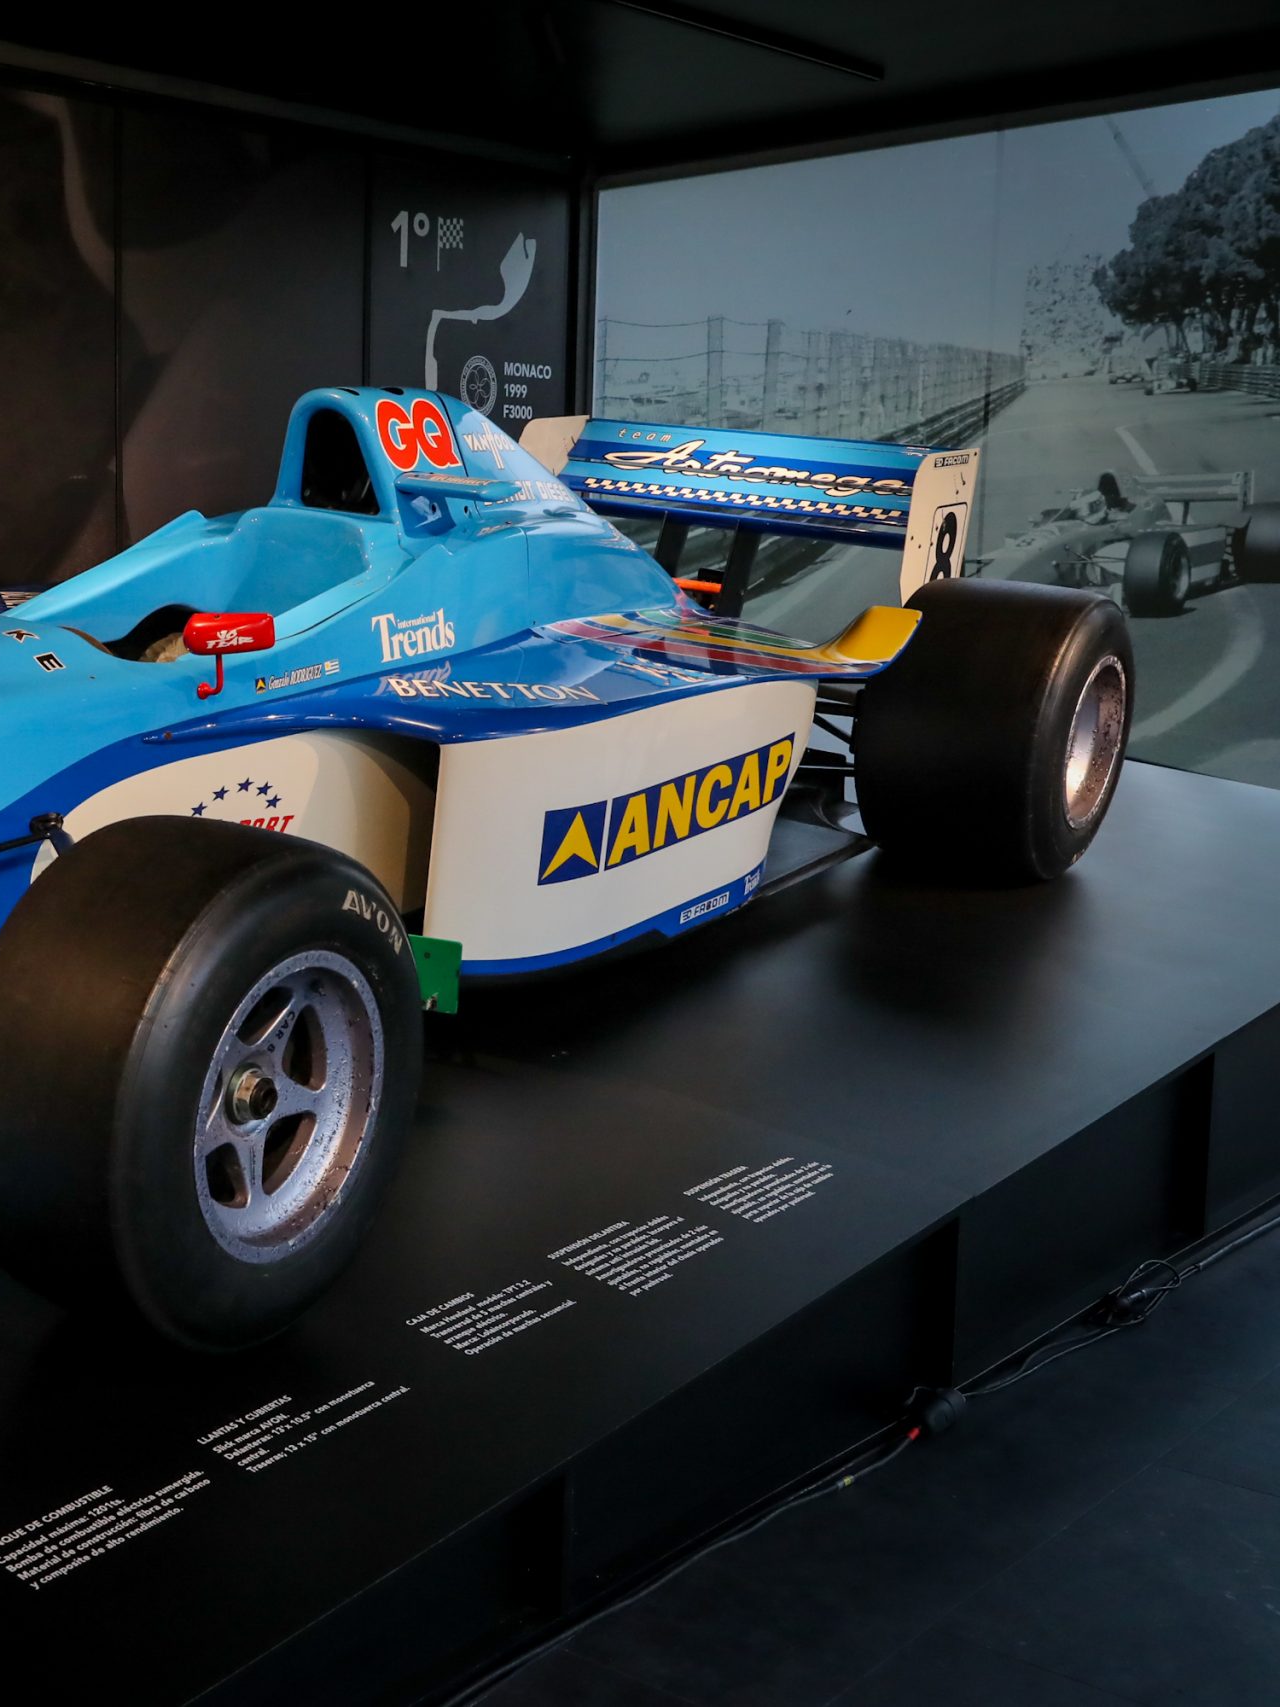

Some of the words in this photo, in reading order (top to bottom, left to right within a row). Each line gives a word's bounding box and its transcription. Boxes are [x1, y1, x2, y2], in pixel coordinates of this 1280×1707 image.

[503, 361, 552, 380] MONACO
[503, 384, 528, 399] 1999
[375, 398, 462, 473] GQ
[503, 404, 533, 420] F3000
[618, 427, 673, 443] team
[943, 454, 969, 466] FACOM
[929, 511, 958, 582] 8
[371, 607, 455, 664] Trends
[386, 677, 602, 702] BENETTON
[606, 738, 794, 868] ANCAP
[341, 889, 404, 956] AVON
[5, 1552, 45, 1573] Bomba
[44, 1545, 59, 1554] de
[58, 1515, 117, 1547] combustible
[116, 1495, 157, 1517] eléctrica
[155, 1471, 205, 1497] sumergida.
[24, 1520, 44, 1532] DE
[42, 1485, 114, 1523] COMBUSTIBLE
[48, 1515, 90, 1539] máxima:
[17, 1554, 62, 1581] Material
[61, 1549, 77, 1559] de
[76, 1517, 139, 1551] construcción:
[135, 1505, 162, 1519] fibra
[160, 1498, 175, 1507] de
[30, 1581, 40, 1591] y
[40, 1555, 91, 1584] composite
[91, 1547, 106, 1557] de
[105, 1537, 126, 1550] alto
[125, 1508, 184, 1539] rendimiento.
